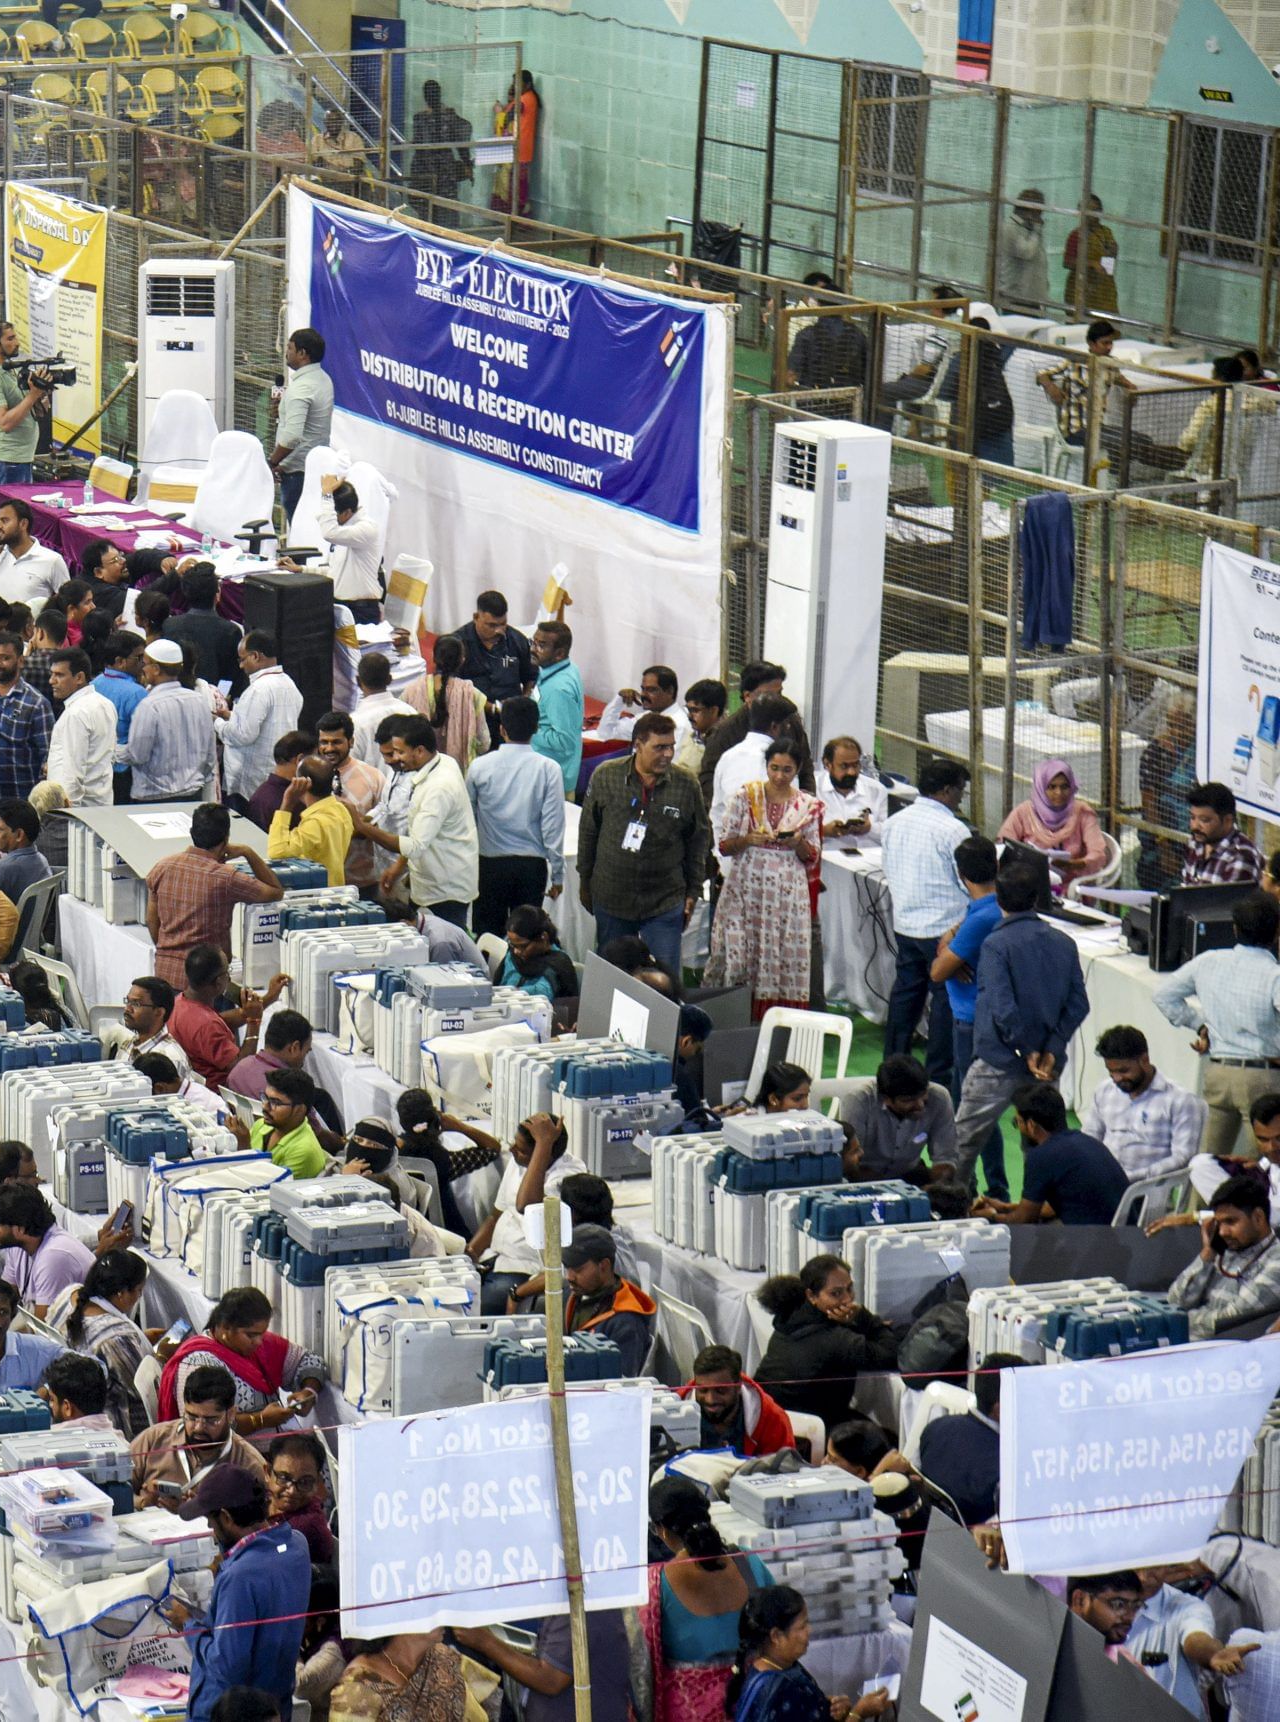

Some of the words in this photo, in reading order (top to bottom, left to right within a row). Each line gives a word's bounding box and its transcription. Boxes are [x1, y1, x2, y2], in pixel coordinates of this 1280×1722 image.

[25, 207, 70, 243] DISPERSAL
[416, 283, 442, 301] JUBILEE
[442, 289, 462, 306] HILLS
[462, 295, 496, 317] ASSEMBLY
[497, 306, 548, 333] CONSTITUENCY
[469, 262, 572, 323] ELECTION
[450, 323, 529, 369] WELCOME
[479, 360, 499, 388] To
[360, 349, 461, 404] DISTRIBUTION
[463, 387, 475, 410] &
[478, 388, 565, 440] RECEPTION
[569, 418, 635, 461] CENTER
[386, 401, 437, 435] 61-JUBILEE
[438, 419, 465, 444] HILLS
[467, 428, 520, 462] ASSEMBLY
[522, 447, 603, 490] CONSTITUENCY
[1253, 627, 1280, 646] Conte
[442, 1020, 464, 1031] BU-02
